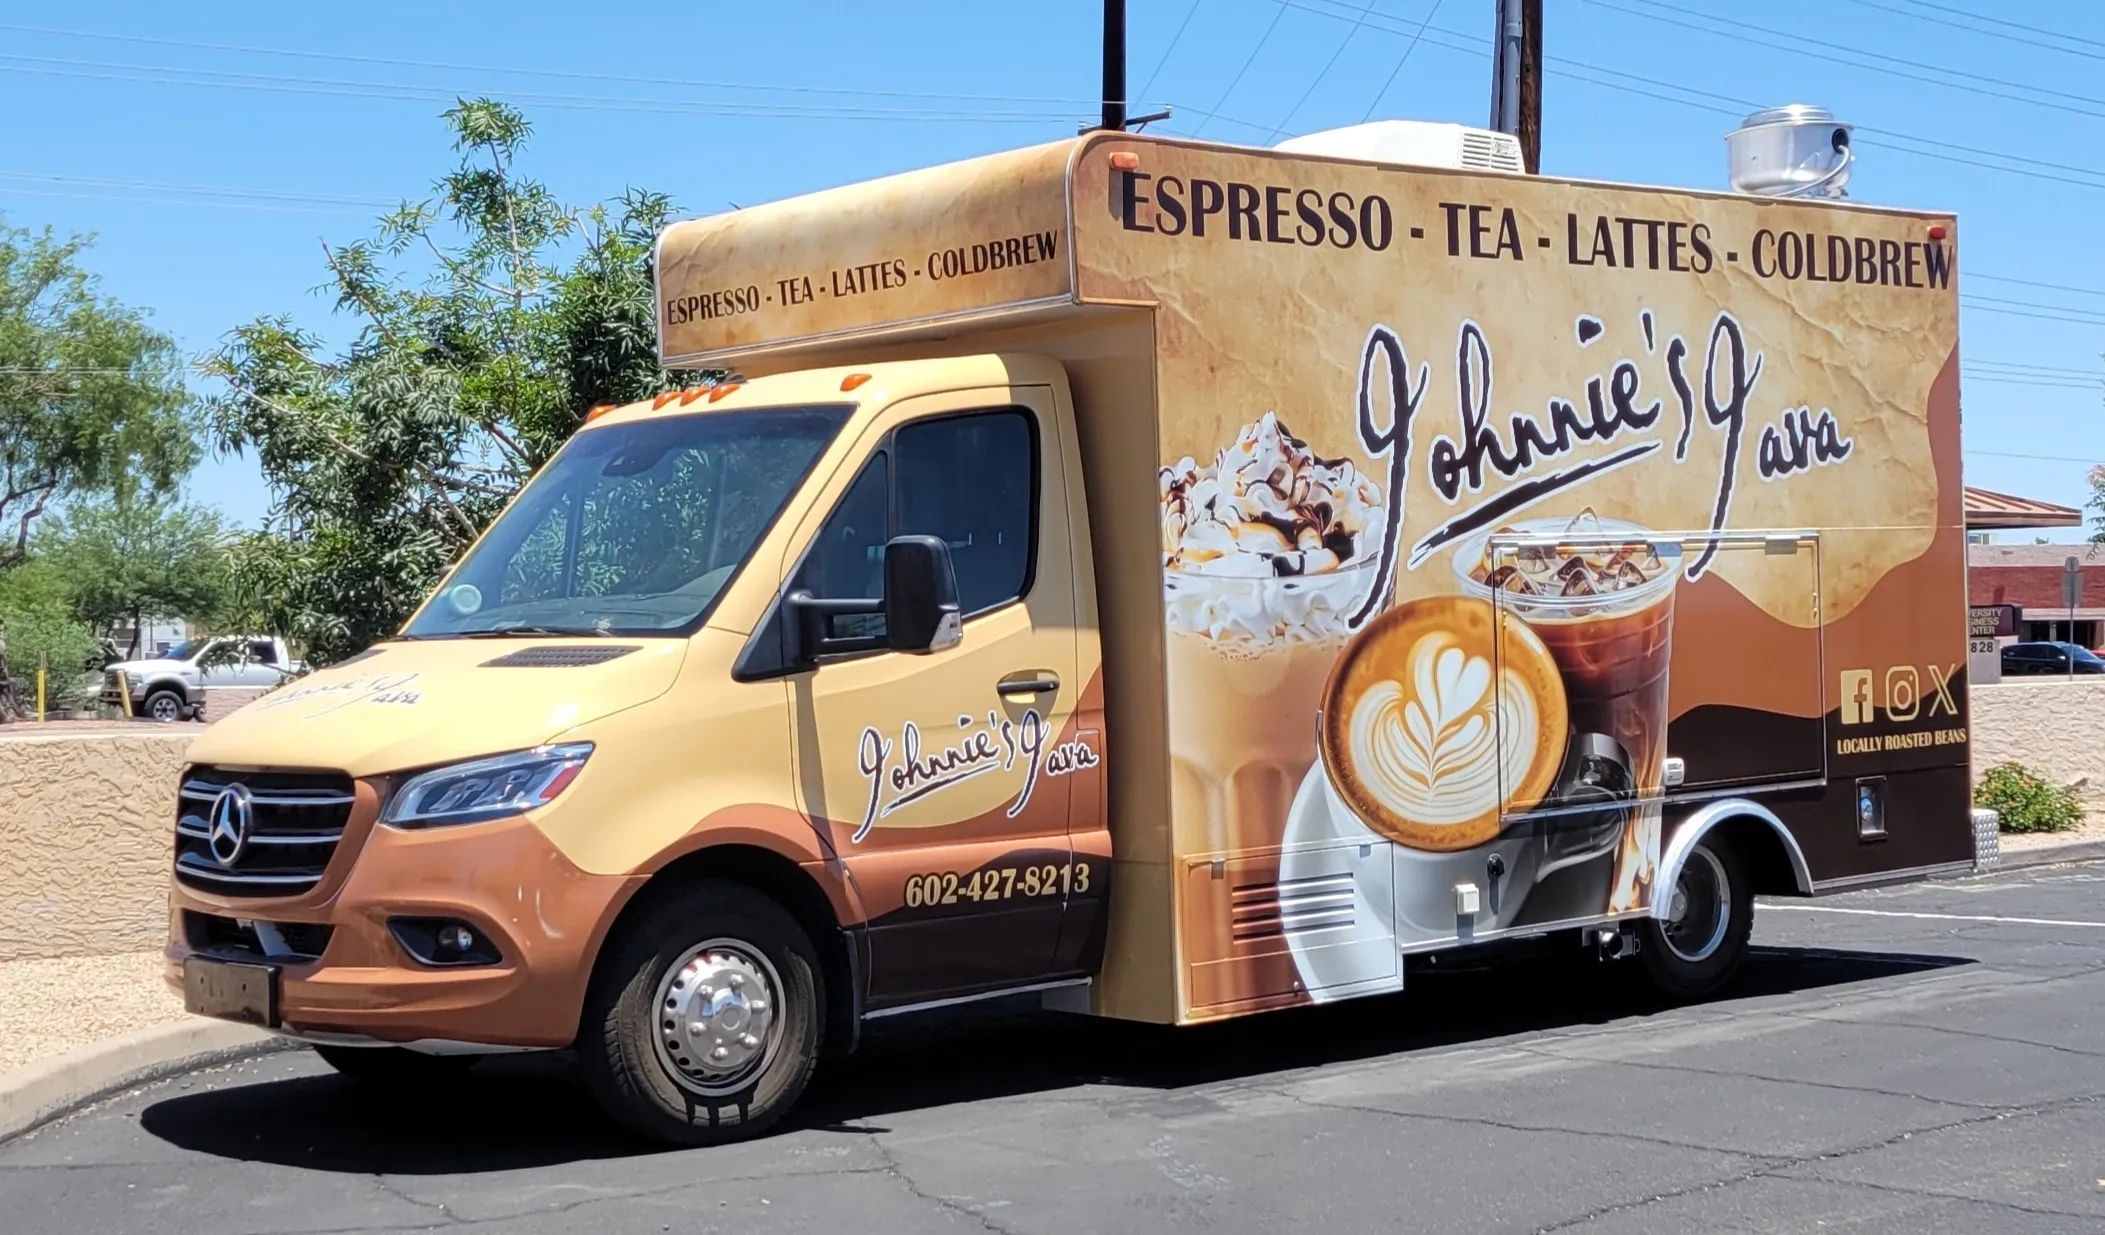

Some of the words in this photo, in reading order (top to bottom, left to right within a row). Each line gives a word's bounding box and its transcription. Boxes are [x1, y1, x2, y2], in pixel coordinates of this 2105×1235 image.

[667, 285, 759, 325] ESPRESSO
[777, 276, 815, 307] TEA
[832, 259, 907, 297] LATTES
[928, 229, 1058, 281] COLDBREW
[1122, 170, 1393, 252] ESPRESSO
[1438, 202, 1524, 261] TEA
[1567, 212, 1714, 275] LATTES
[1751, 228, 1954, 290] COLDBREW
[1348, 311, 1694, 630] Johnnie's
[1687, 313, 1852, 580] Java
[1970, 641, 1994, 653] 828
[854, 711, 1015, 841] Johnnie's
[1007, 710, 1098, 817] Java
[1837, 735, 1883, 755] LOCALLY
[1885, 732, 1933, 751] ROASTED
[1935, 727, 1967, 746] BEANS
[906, 863, 1090, 908] 602-427-8213
